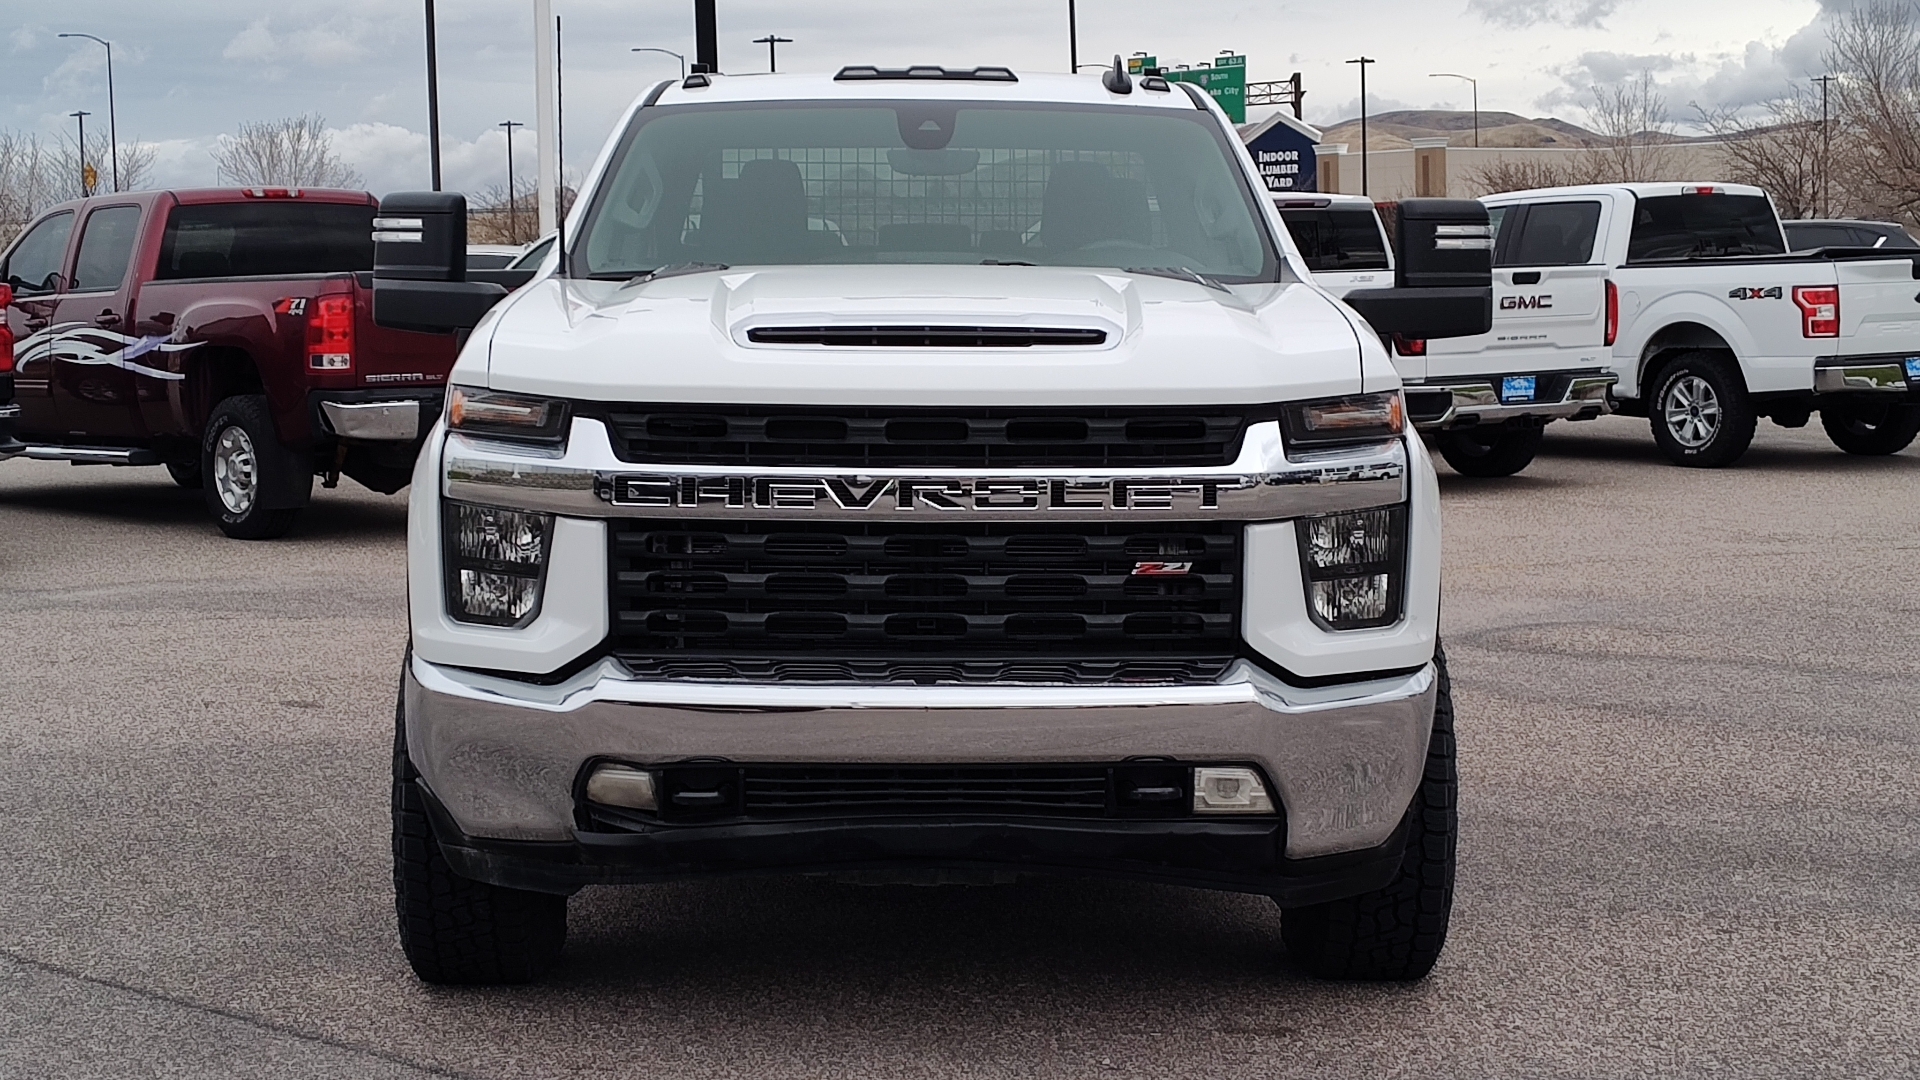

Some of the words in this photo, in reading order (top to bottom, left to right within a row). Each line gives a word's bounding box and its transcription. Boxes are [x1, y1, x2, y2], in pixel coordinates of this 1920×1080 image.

[1258, 150, 1299, 162] INDOOR
[1259, 163, 1299, 175] LUMBER
[1265, 175, 1293, 188] YARD
[1500, 295, 1552, 310] GMC
[365, 371, 424, 383] SIERRA
[611, 475, 1242, 510] CHEVROLET
[1131, 561, 1193, 575] Z71
